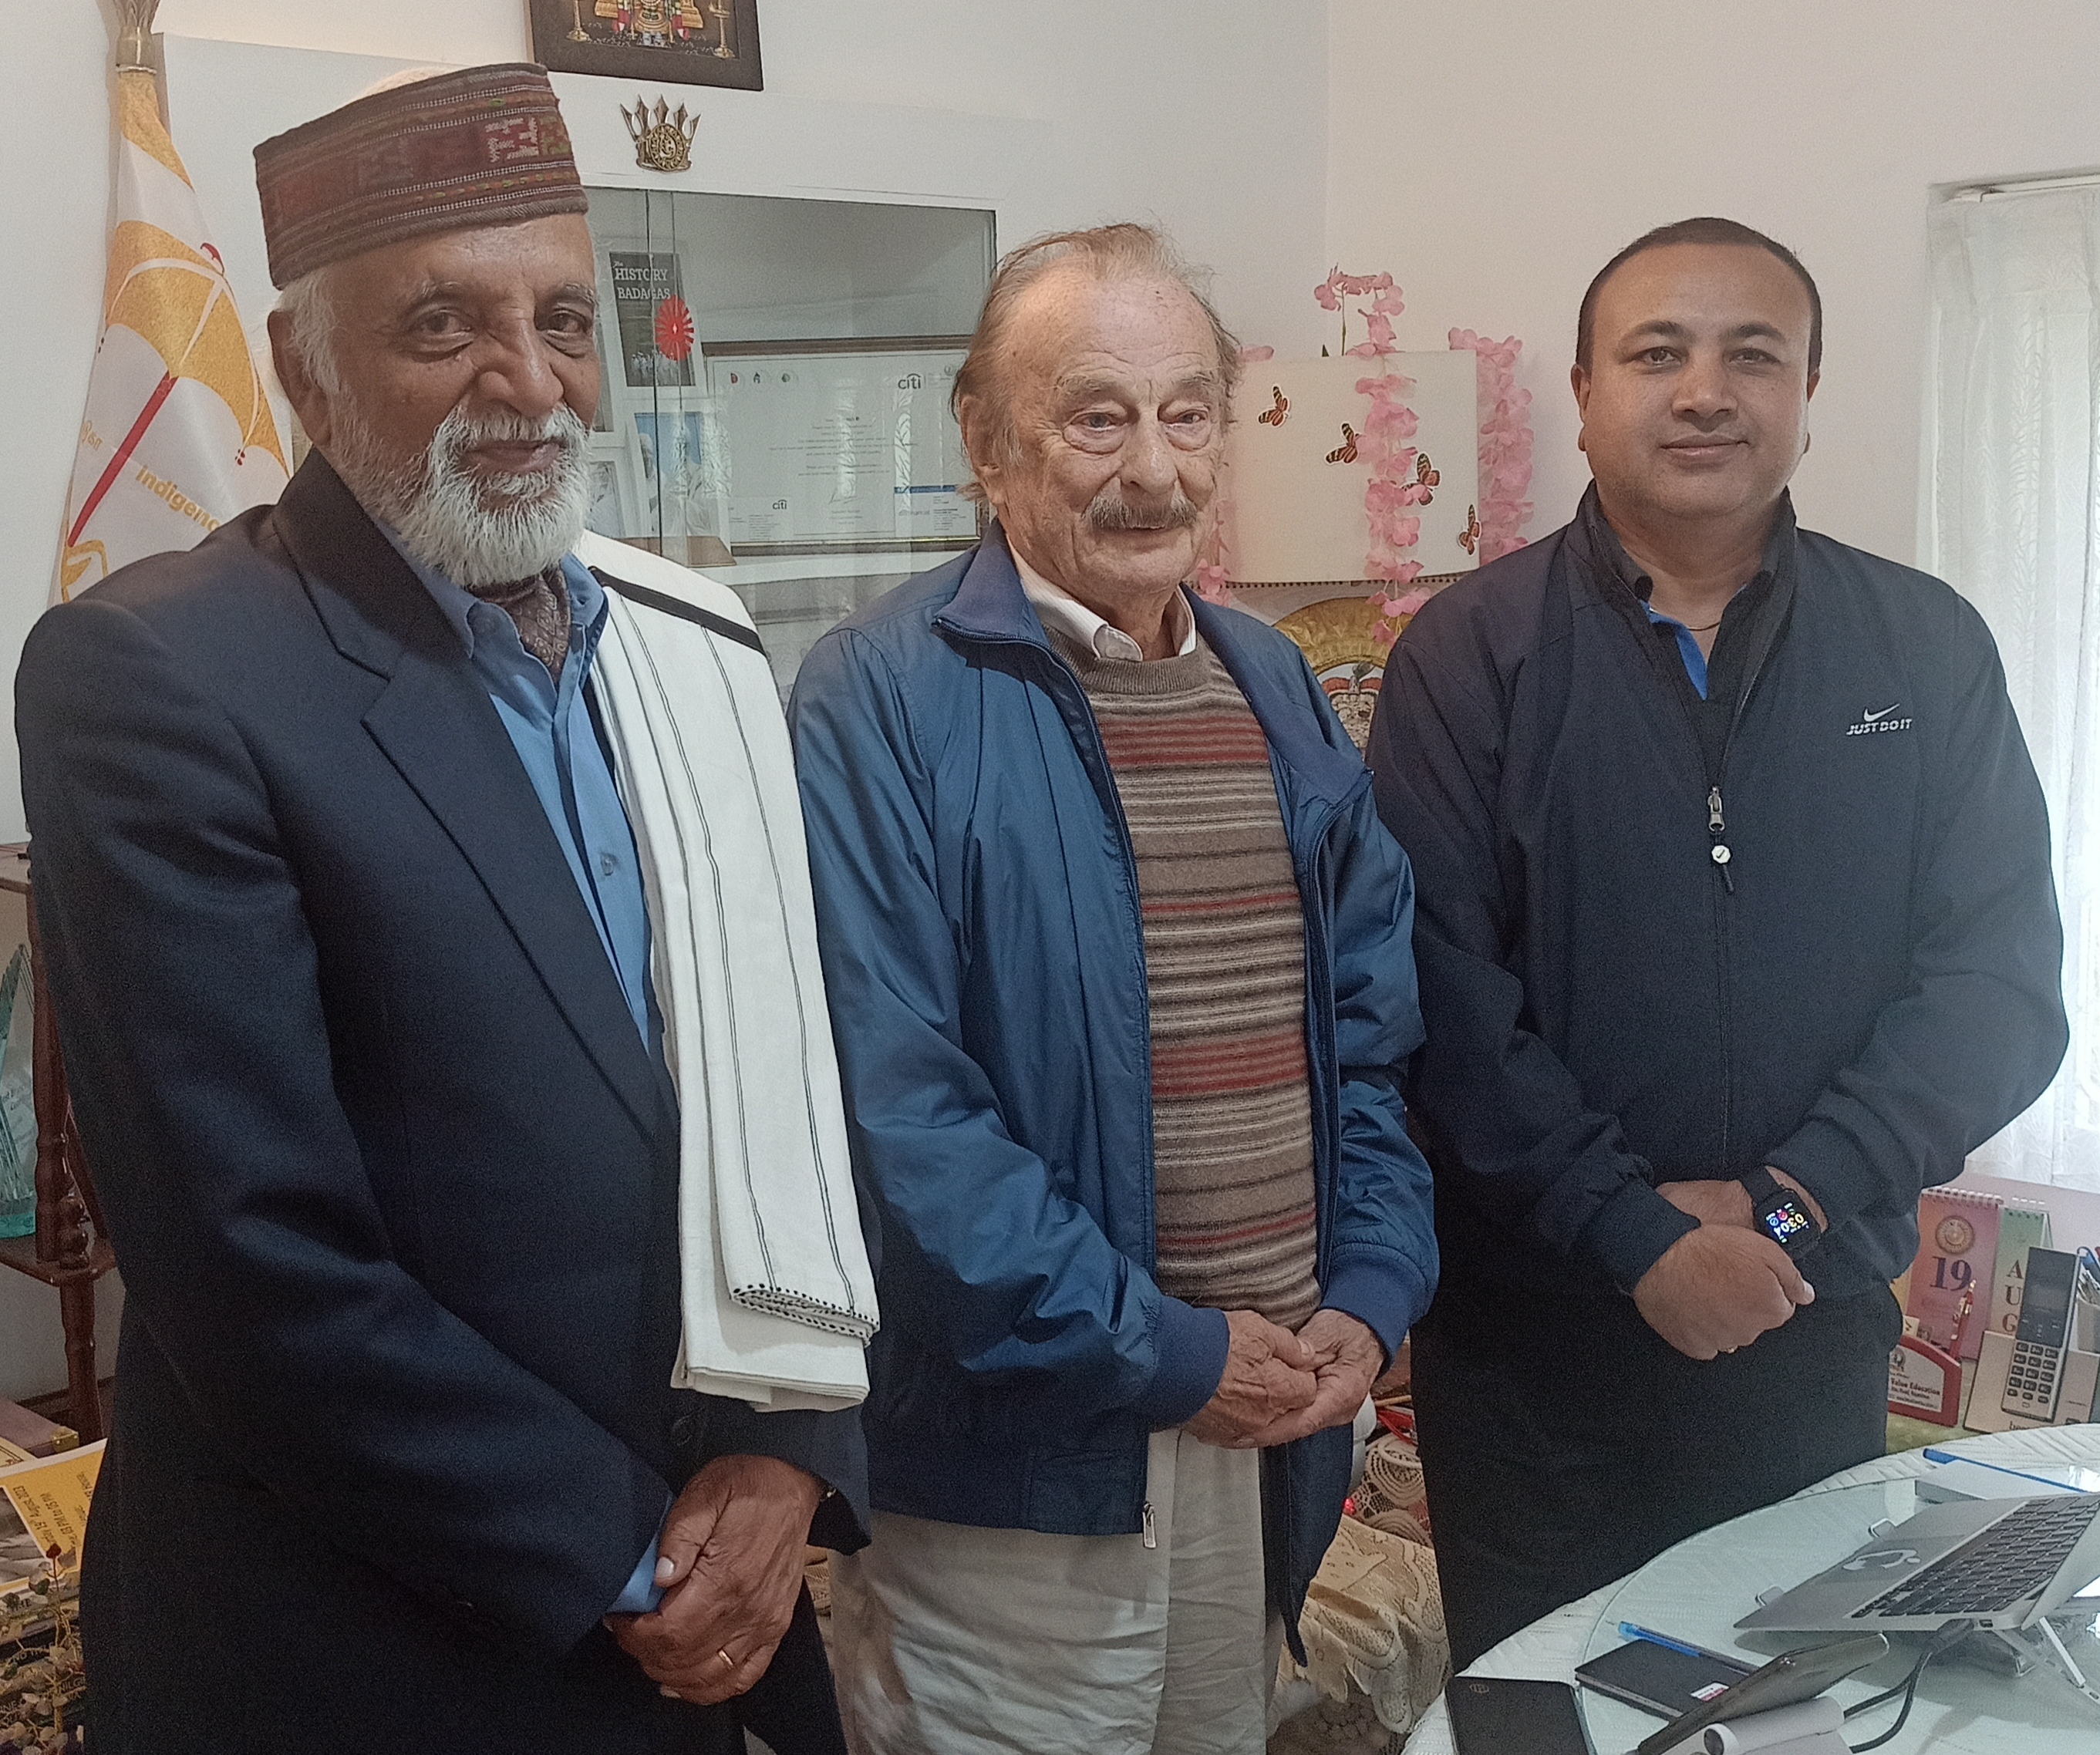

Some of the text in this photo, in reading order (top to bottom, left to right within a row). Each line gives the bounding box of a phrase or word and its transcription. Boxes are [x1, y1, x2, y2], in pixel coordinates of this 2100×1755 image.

[615, 268, 669, 281] HISTORY
[617, 287, 670, 299] BADAGAS
[897, 373, 922, 389] citi
[772, 499, 787, 510] citi
[1846, 719, 1913, 736] JUST DO IT
[1930, 1255, 1972, 1292] 19
[2003, 1258, 2024, 1333] AUG
